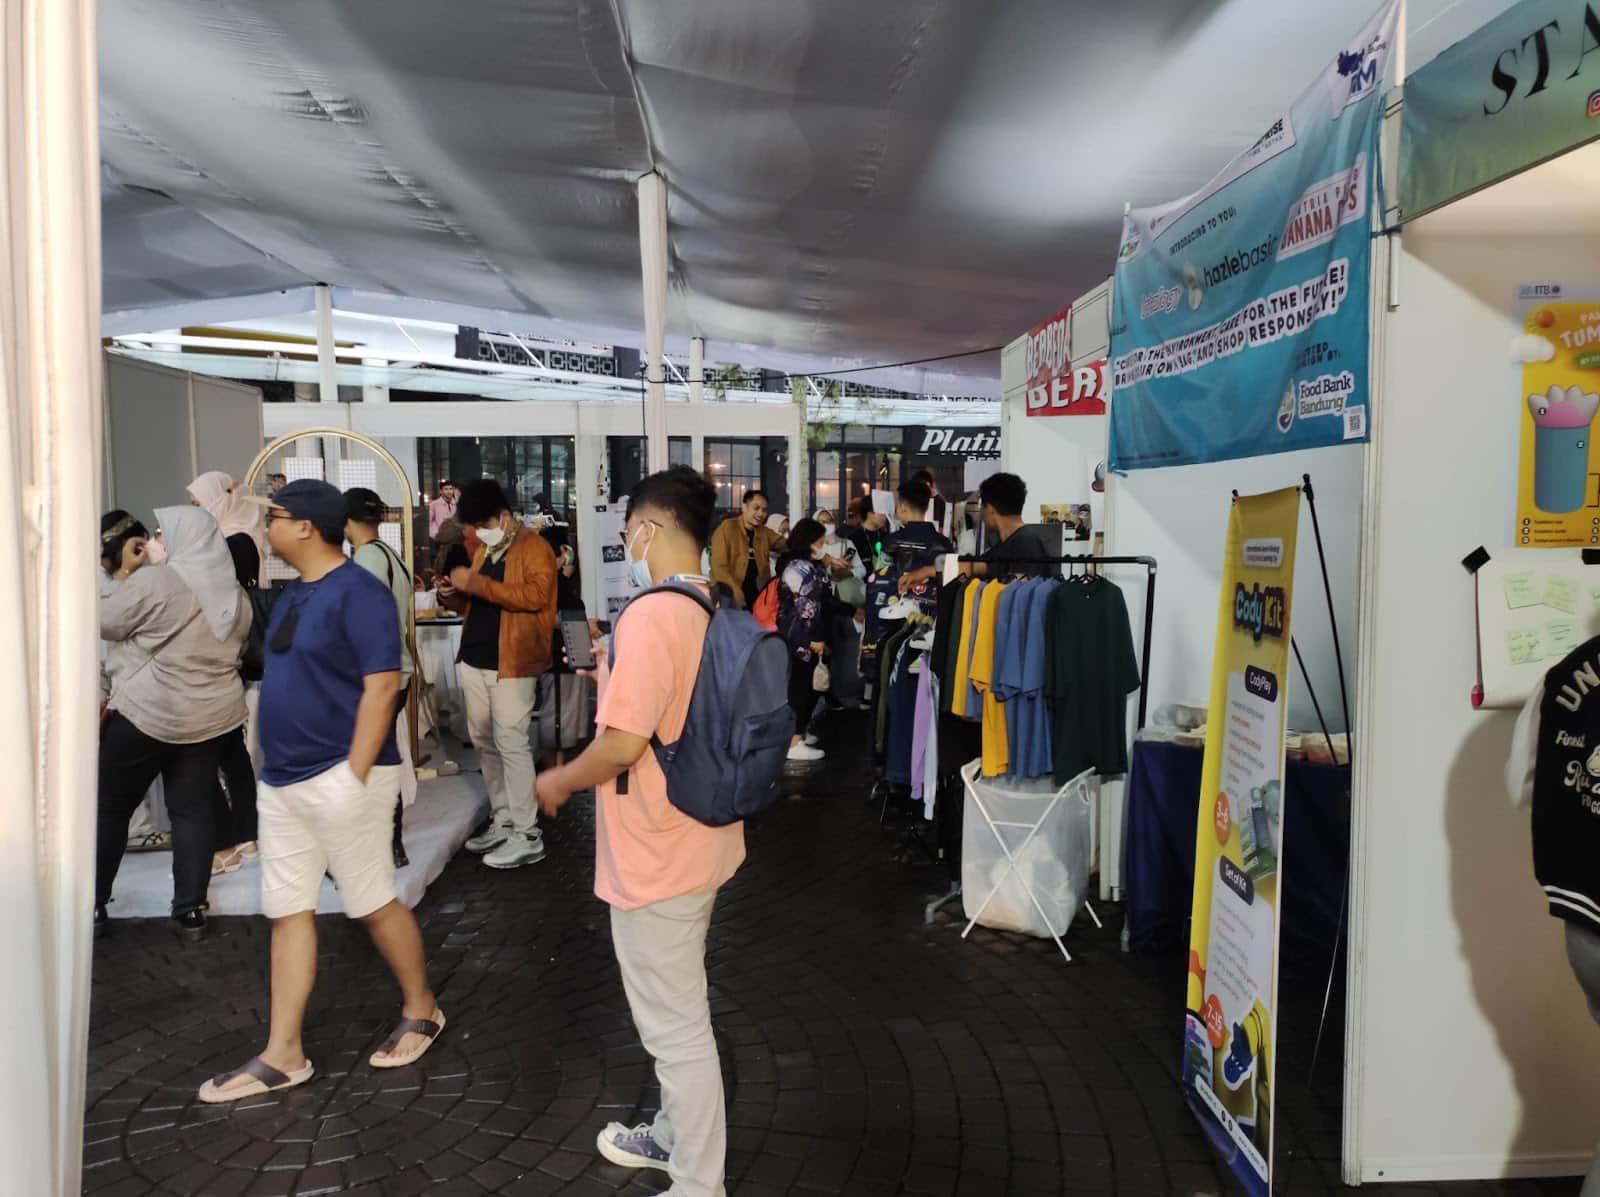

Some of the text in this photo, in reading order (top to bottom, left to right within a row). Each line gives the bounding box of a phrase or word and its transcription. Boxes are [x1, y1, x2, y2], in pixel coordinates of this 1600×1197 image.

[1243, 302, 1266, 325] FOR
[1270, 290, 1298, 315] THE
[1216, 330, 1245, 355] SHOP
[1300, 374, 1351, 399] Food Bank
